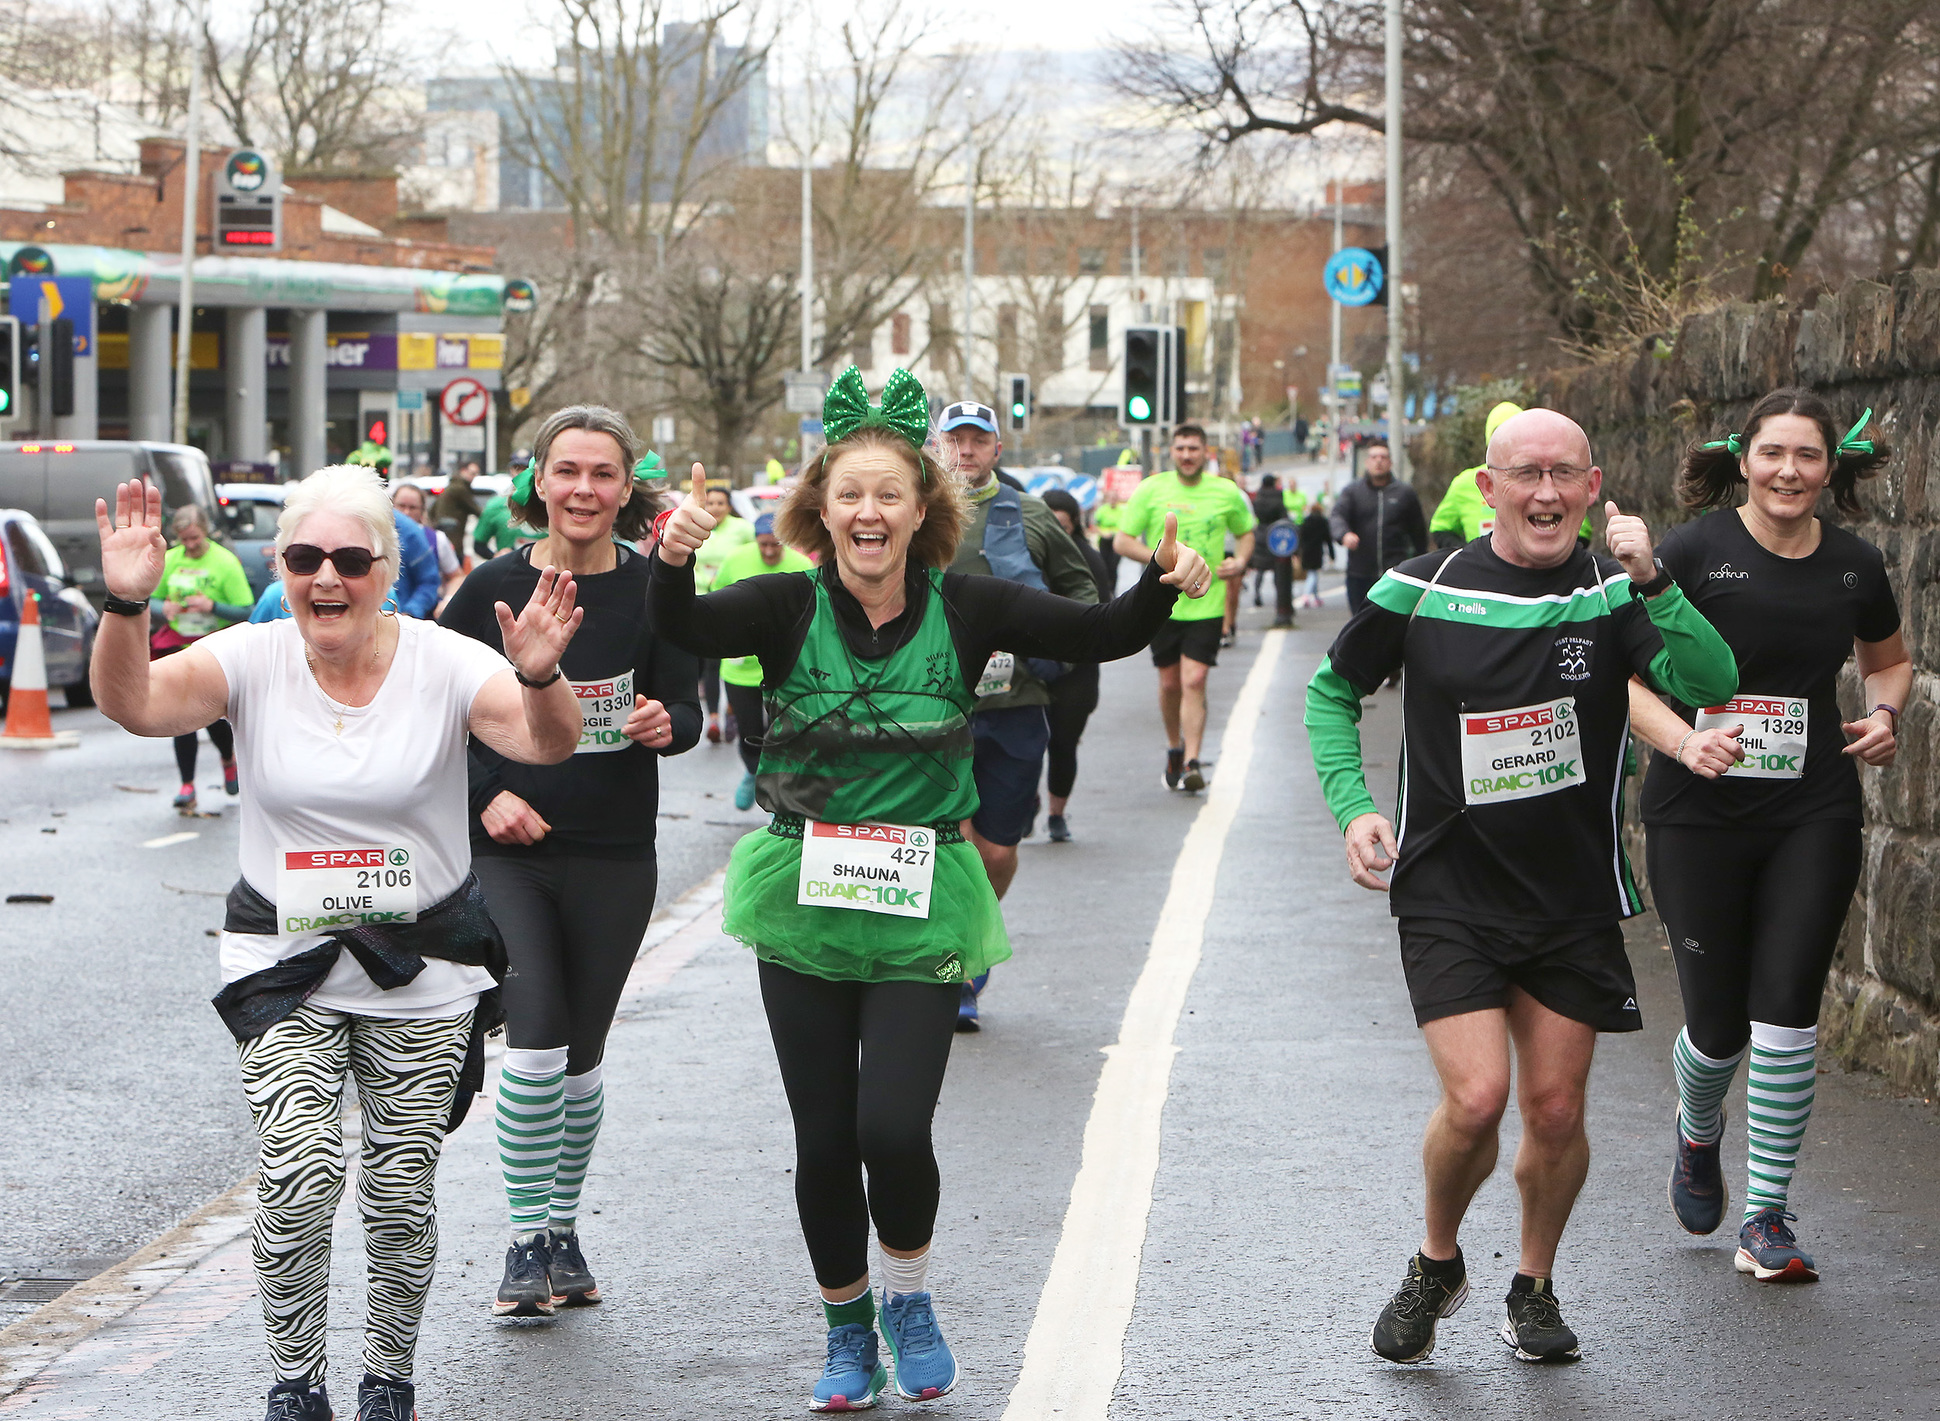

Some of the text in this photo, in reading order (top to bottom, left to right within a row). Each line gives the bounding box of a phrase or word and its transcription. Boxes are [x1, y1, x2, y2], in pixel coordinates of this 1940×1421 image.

[1709, 567, 1749, 581] parkrun
[925, 652, 950, 662] BELFAS
[572, 685, 613, 697] PAR
[591, 692, 632, 713] 1330
[1725, 701, 1784, 714] SPAR
[1486, 710, 1552, 731] SPAR
[1761, 718, 1804, 735] 1329
[1530, 720, 1576, 746] 2102
[1736, 738, 1767, 750] PHIL
[1491, 750, 1556, 770] GERARD
[837, 825, 905, 842] SPAR
[311, 852, 383, 866] SPAR
[890, 847, 930, 866] 427
[356, 869, 412, 888] 2106
[833, 864, 901, 883] SHAUNA
[322, 896, 373, 910] OLIVE
